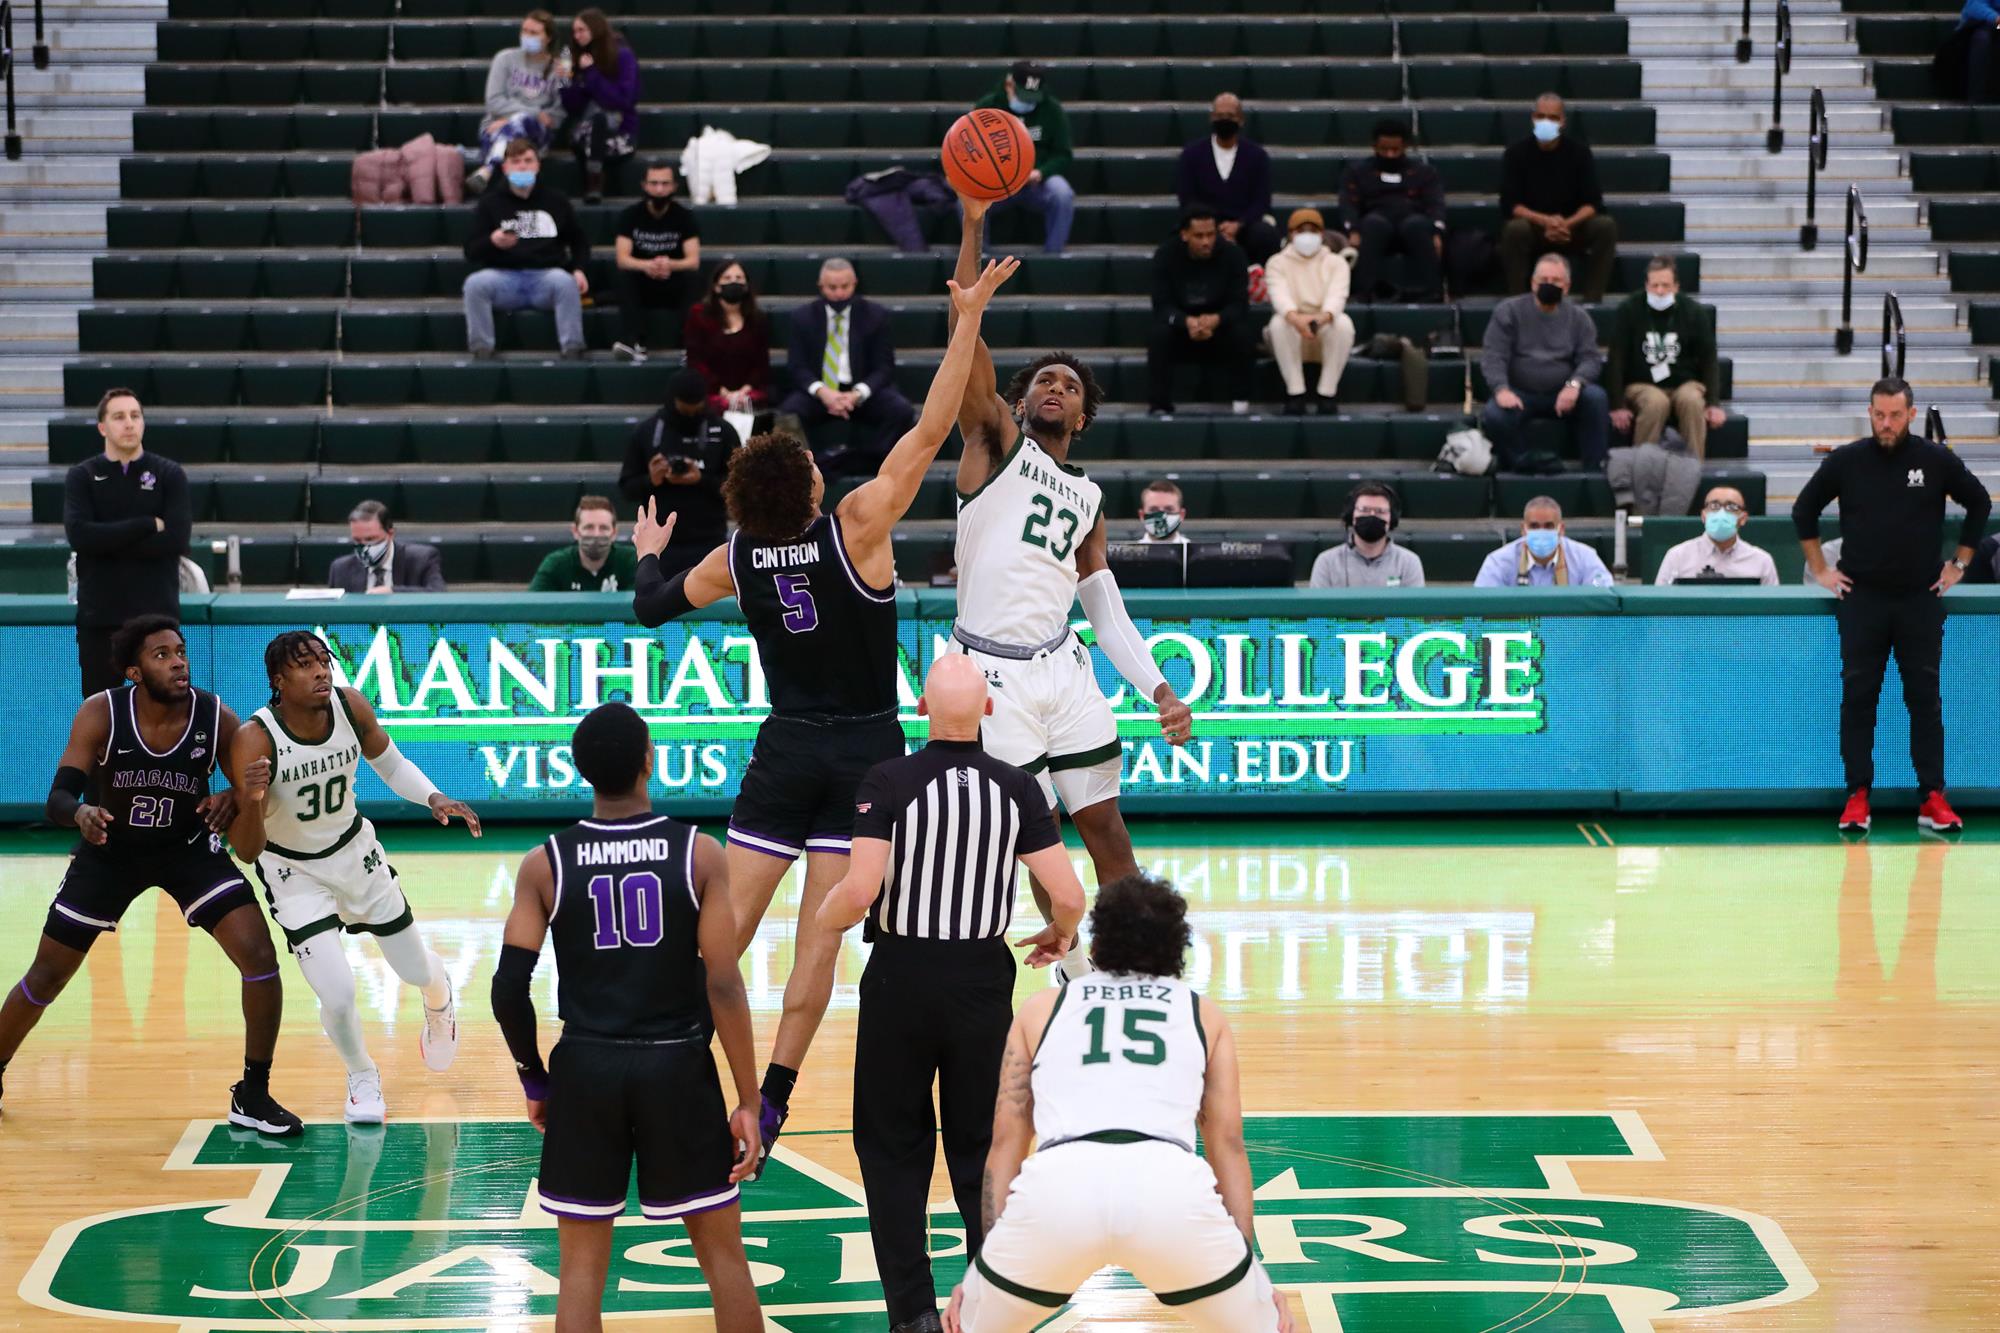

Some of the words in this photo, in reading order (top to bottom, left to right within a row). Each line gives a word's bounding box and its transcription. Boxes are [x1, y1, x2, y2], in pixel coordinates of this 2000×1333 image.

[988, 129, 1012, 164] ROCK
[1019, 459, 1091, 520] MANHATTAN
[1021, 493, 1079, 562] 23
[752, 541, 820, 569] CINTRON
[773, 573, 819, 634] 5
[313, 624, 949, 712] MANHAT
[1069, 620, 1536, 706] OLLEGE
[112, 769, 200, 795] NIAGARA
[281, 744, 358, 783] MANHATTAN
[477, 746, 593, 788] VIS
[655, 745, 727, 787] US
[129, 795, 174, 828] 21
[296, 774, 347, 822] 30
[577, 838, 669, 866] HAMMOND
[587, 871, 664, 950] 10
[1082, 984, 1172, 1004] PEREZ
[1082, 1006, 1167, 1066] 15
[188, 1213, 1638, 1300] JASPRS
